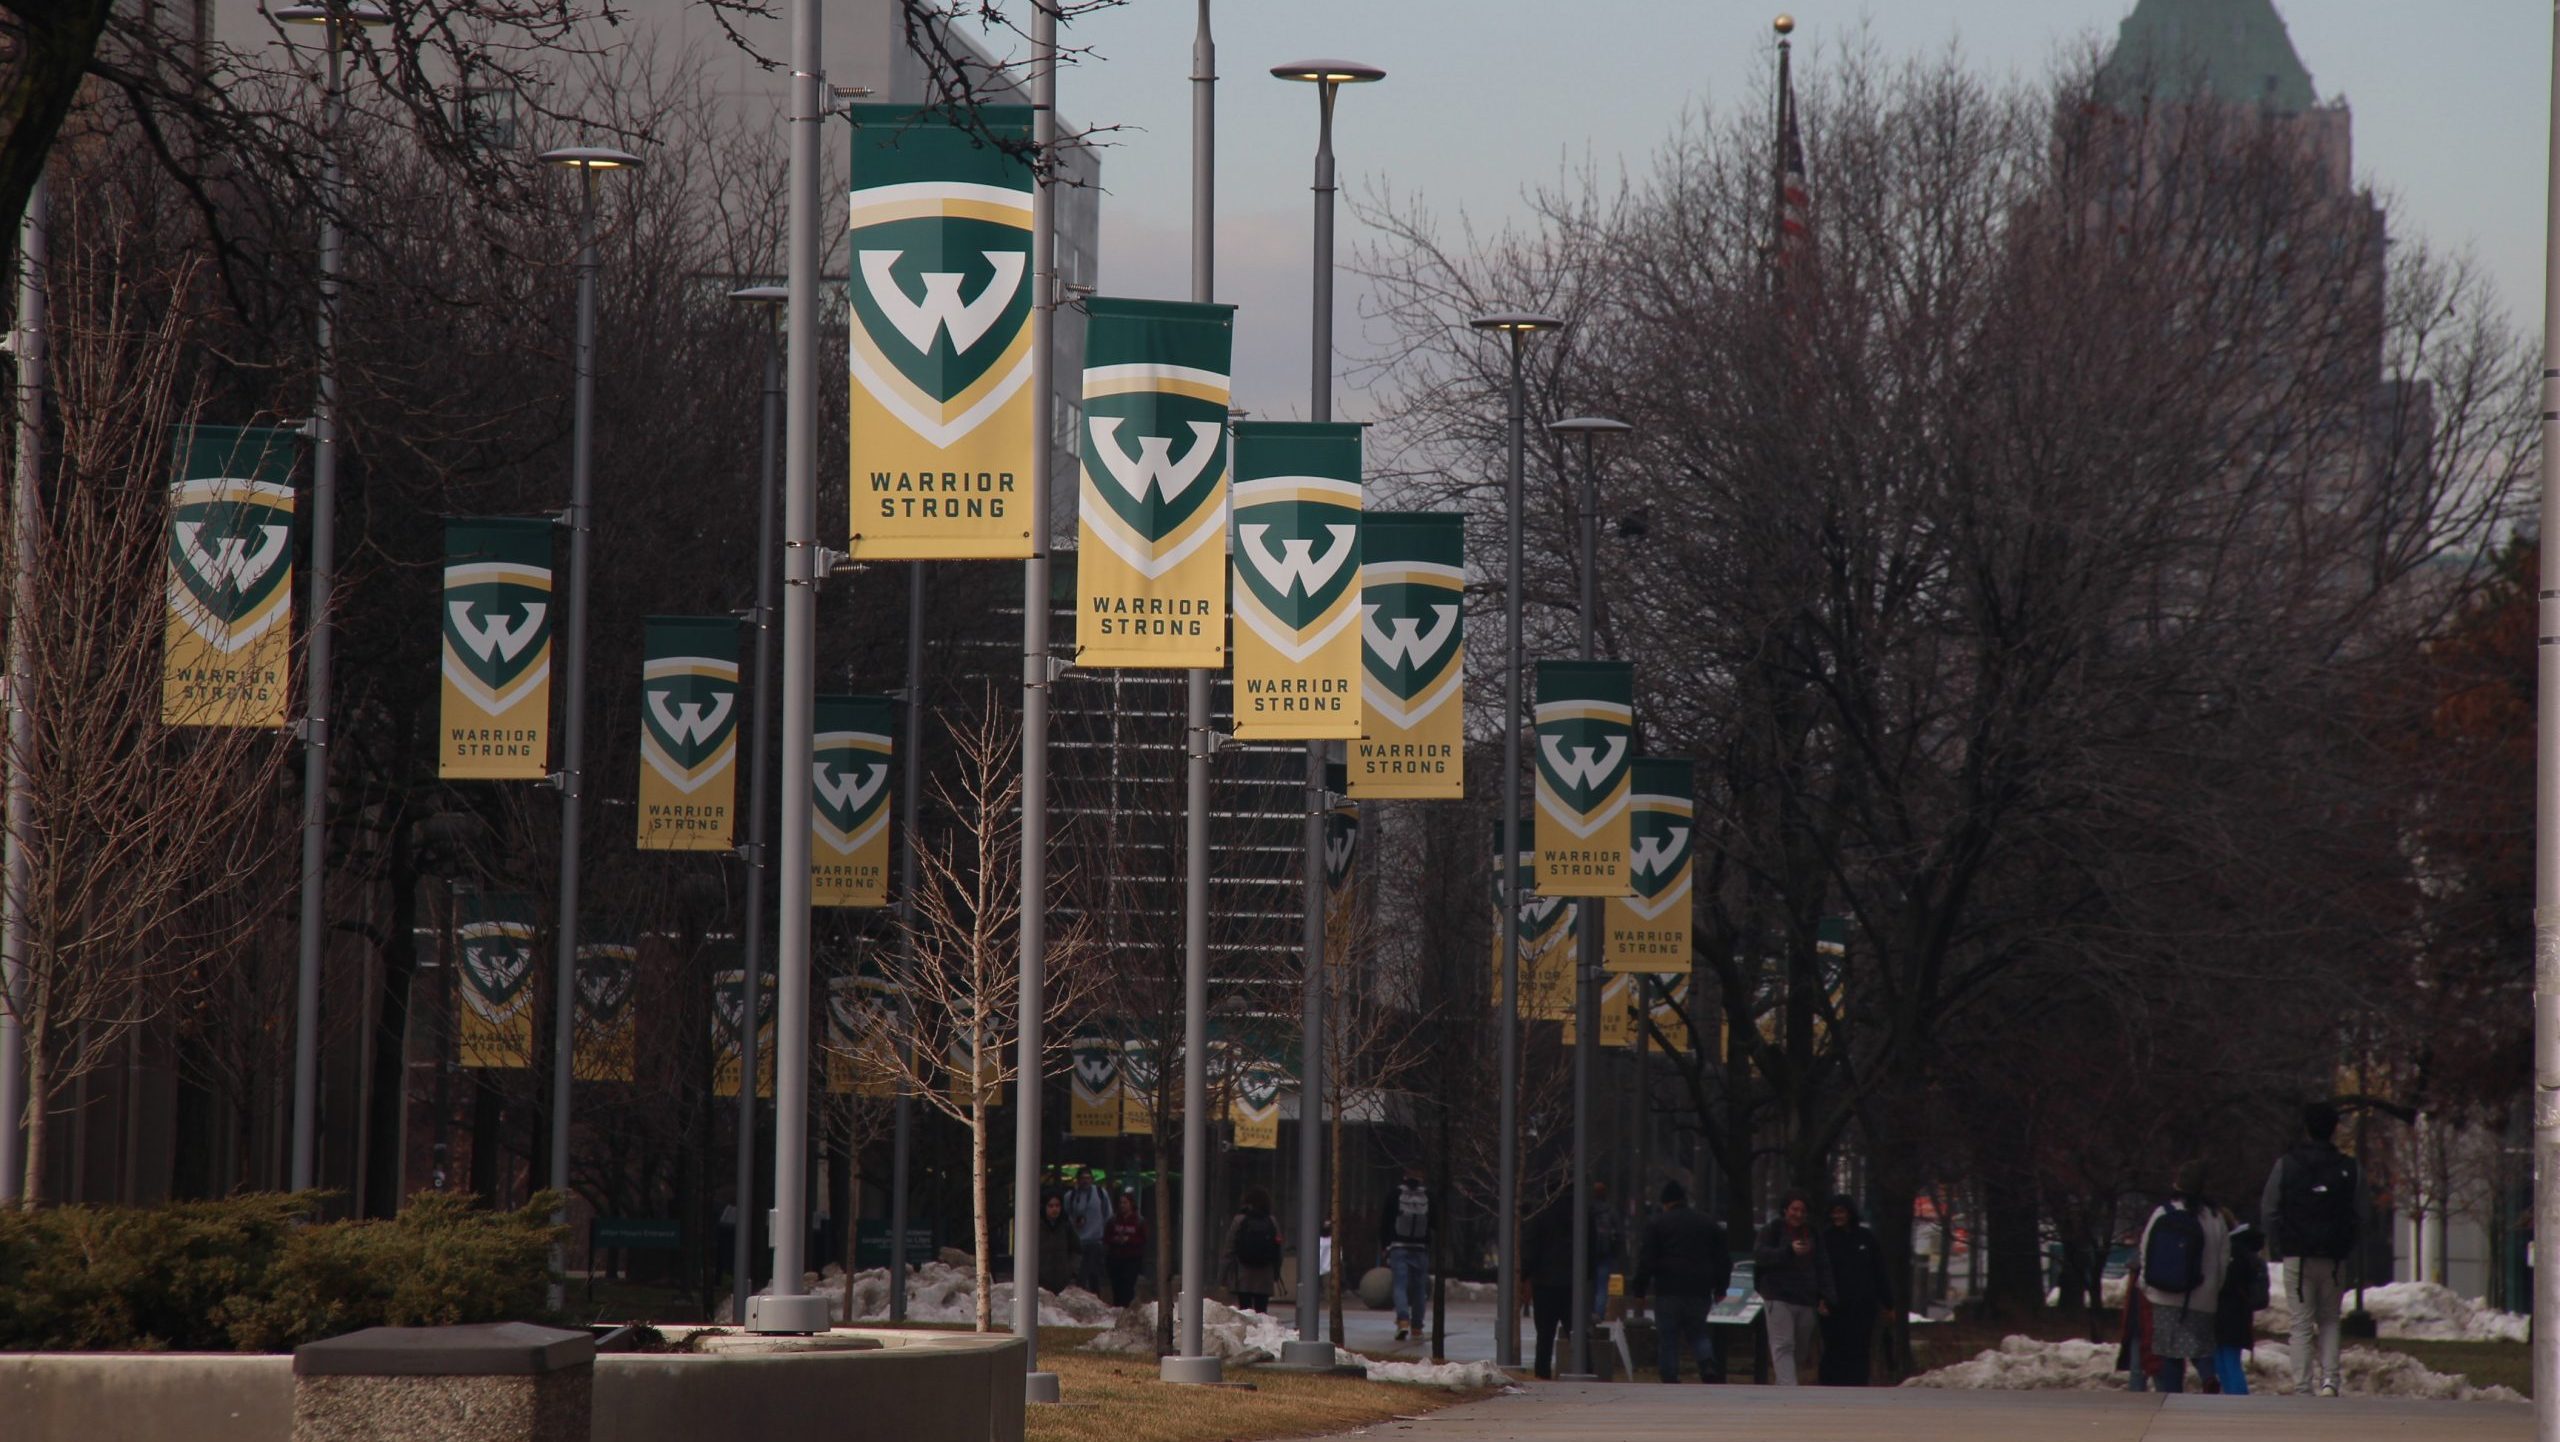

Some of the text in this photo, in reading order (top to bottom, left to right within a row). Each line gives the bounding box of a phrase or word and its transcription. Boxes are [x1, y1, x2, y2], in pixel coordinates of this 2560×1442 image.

[870, 472, 1015, 492] WARRIOR
[881, 498, 1004, 518] STRONG
[1093, 597, 1209, 615] WARRIOR
[1101, 618, 1201, 635] STRONG
[1247, 679, 1349, 693] WARRIOR
[1254, 697, 1342, 711] STRONG
[452, 729, 536, 742] WARRIOR
[458, 744, 531, 756] STRONG
[1359, 744, 1451, 757] WARRIOR
[1366, 761, 1445, 774] STRONG
[649, 804, 724, 817] WARRIOR
[654, 818, 719, 831] STRONG
[1545, 851, 1621, 863] WARRIOR
[811, 865, 879, 876] WARRIOR
[1551, 864, 1616, 876] STRONG
[816, 877, 874, 888] STRONG
[1614, 930, 1683, 942] WARRIOR
[1619, 943, 1679, 955] STRONG
